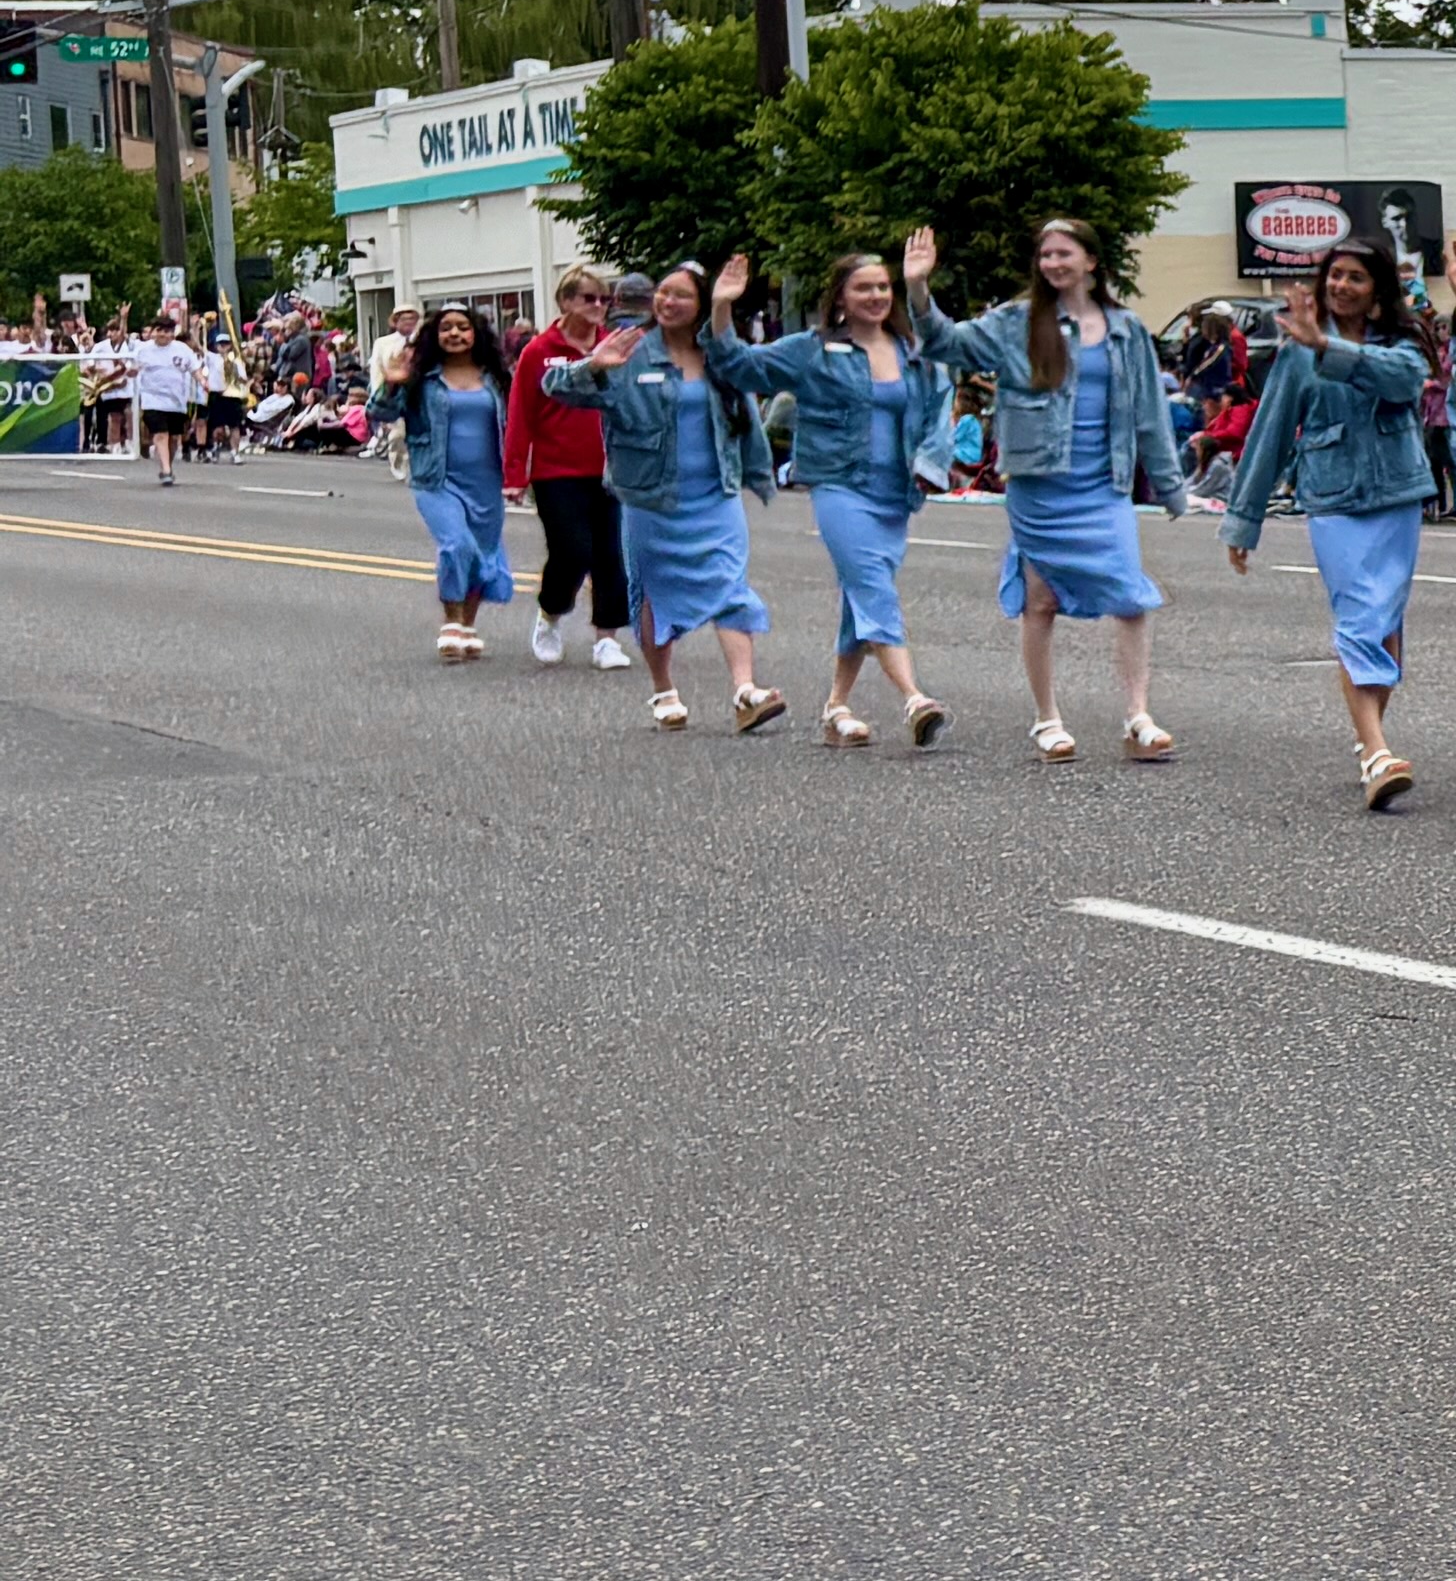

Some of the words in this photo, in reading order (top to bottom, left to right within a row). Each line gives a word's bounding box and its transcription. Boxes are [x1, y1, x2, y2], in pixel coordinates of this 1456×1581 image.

[420, 121, 455, 167] ONE
[458, 113, 493, 161] TAIL
[498, 107, 516, 153] AT
[523, 100, 536, 150] A
